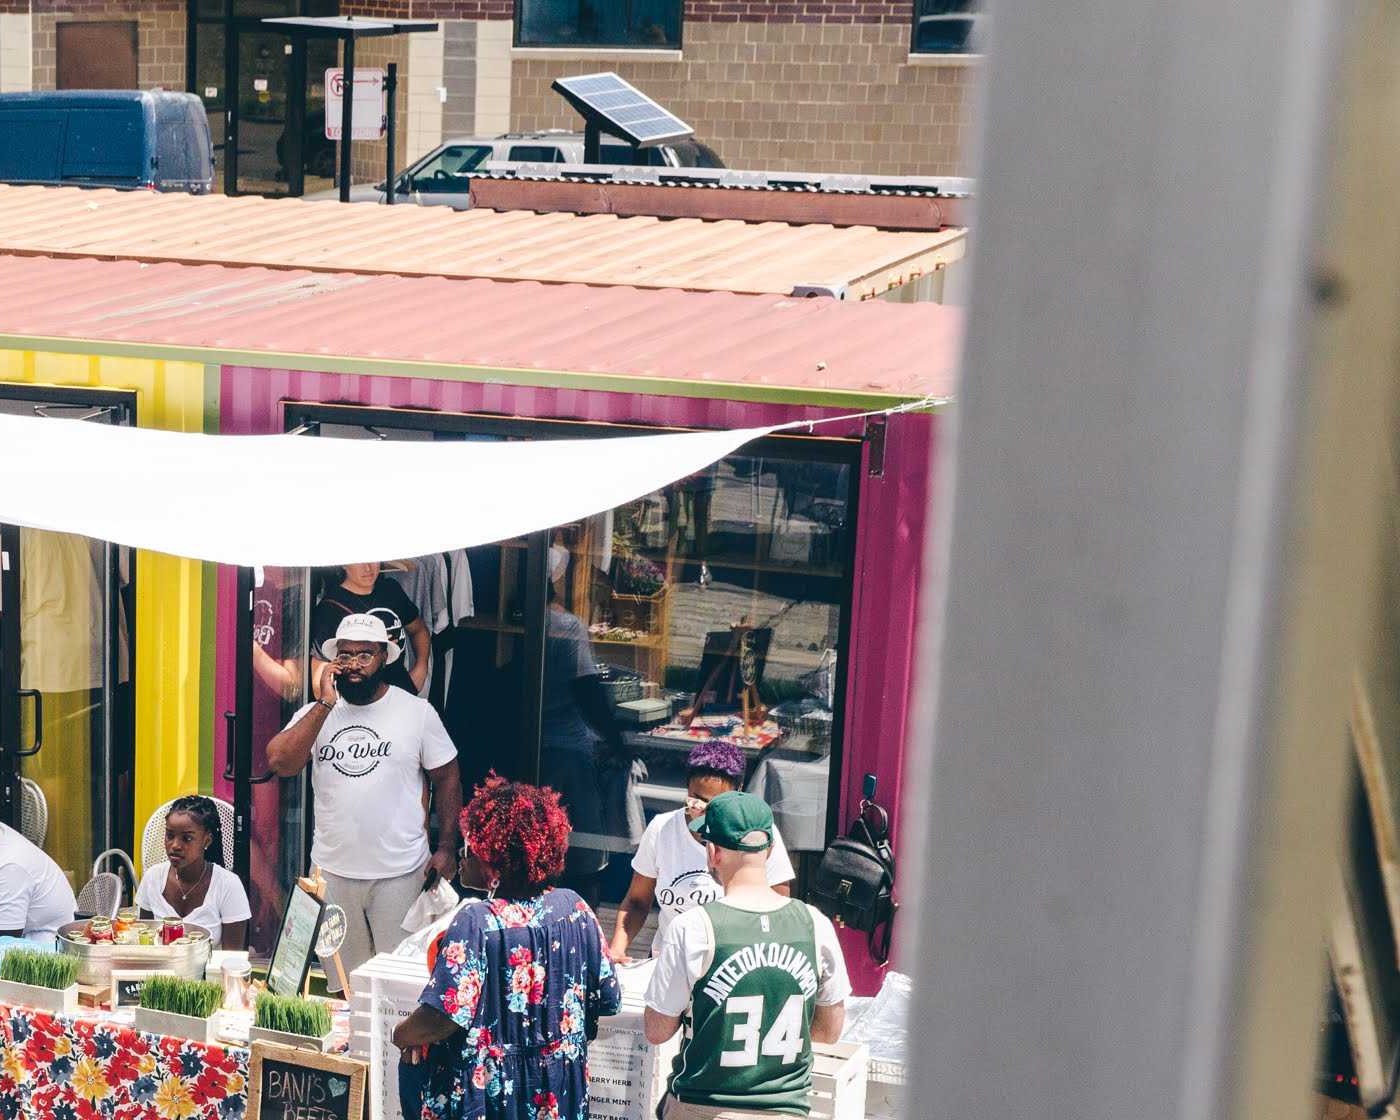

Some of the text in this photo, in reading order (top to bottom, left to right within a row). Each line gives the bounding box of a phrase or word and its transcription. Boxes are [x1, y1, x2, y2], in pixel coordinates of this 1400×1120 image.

[318, 741, 393, 762] Do Well
[660, 888, 684, 906] Do
[719, 994, 806, 1068] 34
[268, 1070, 326, 1105] BANI'S
